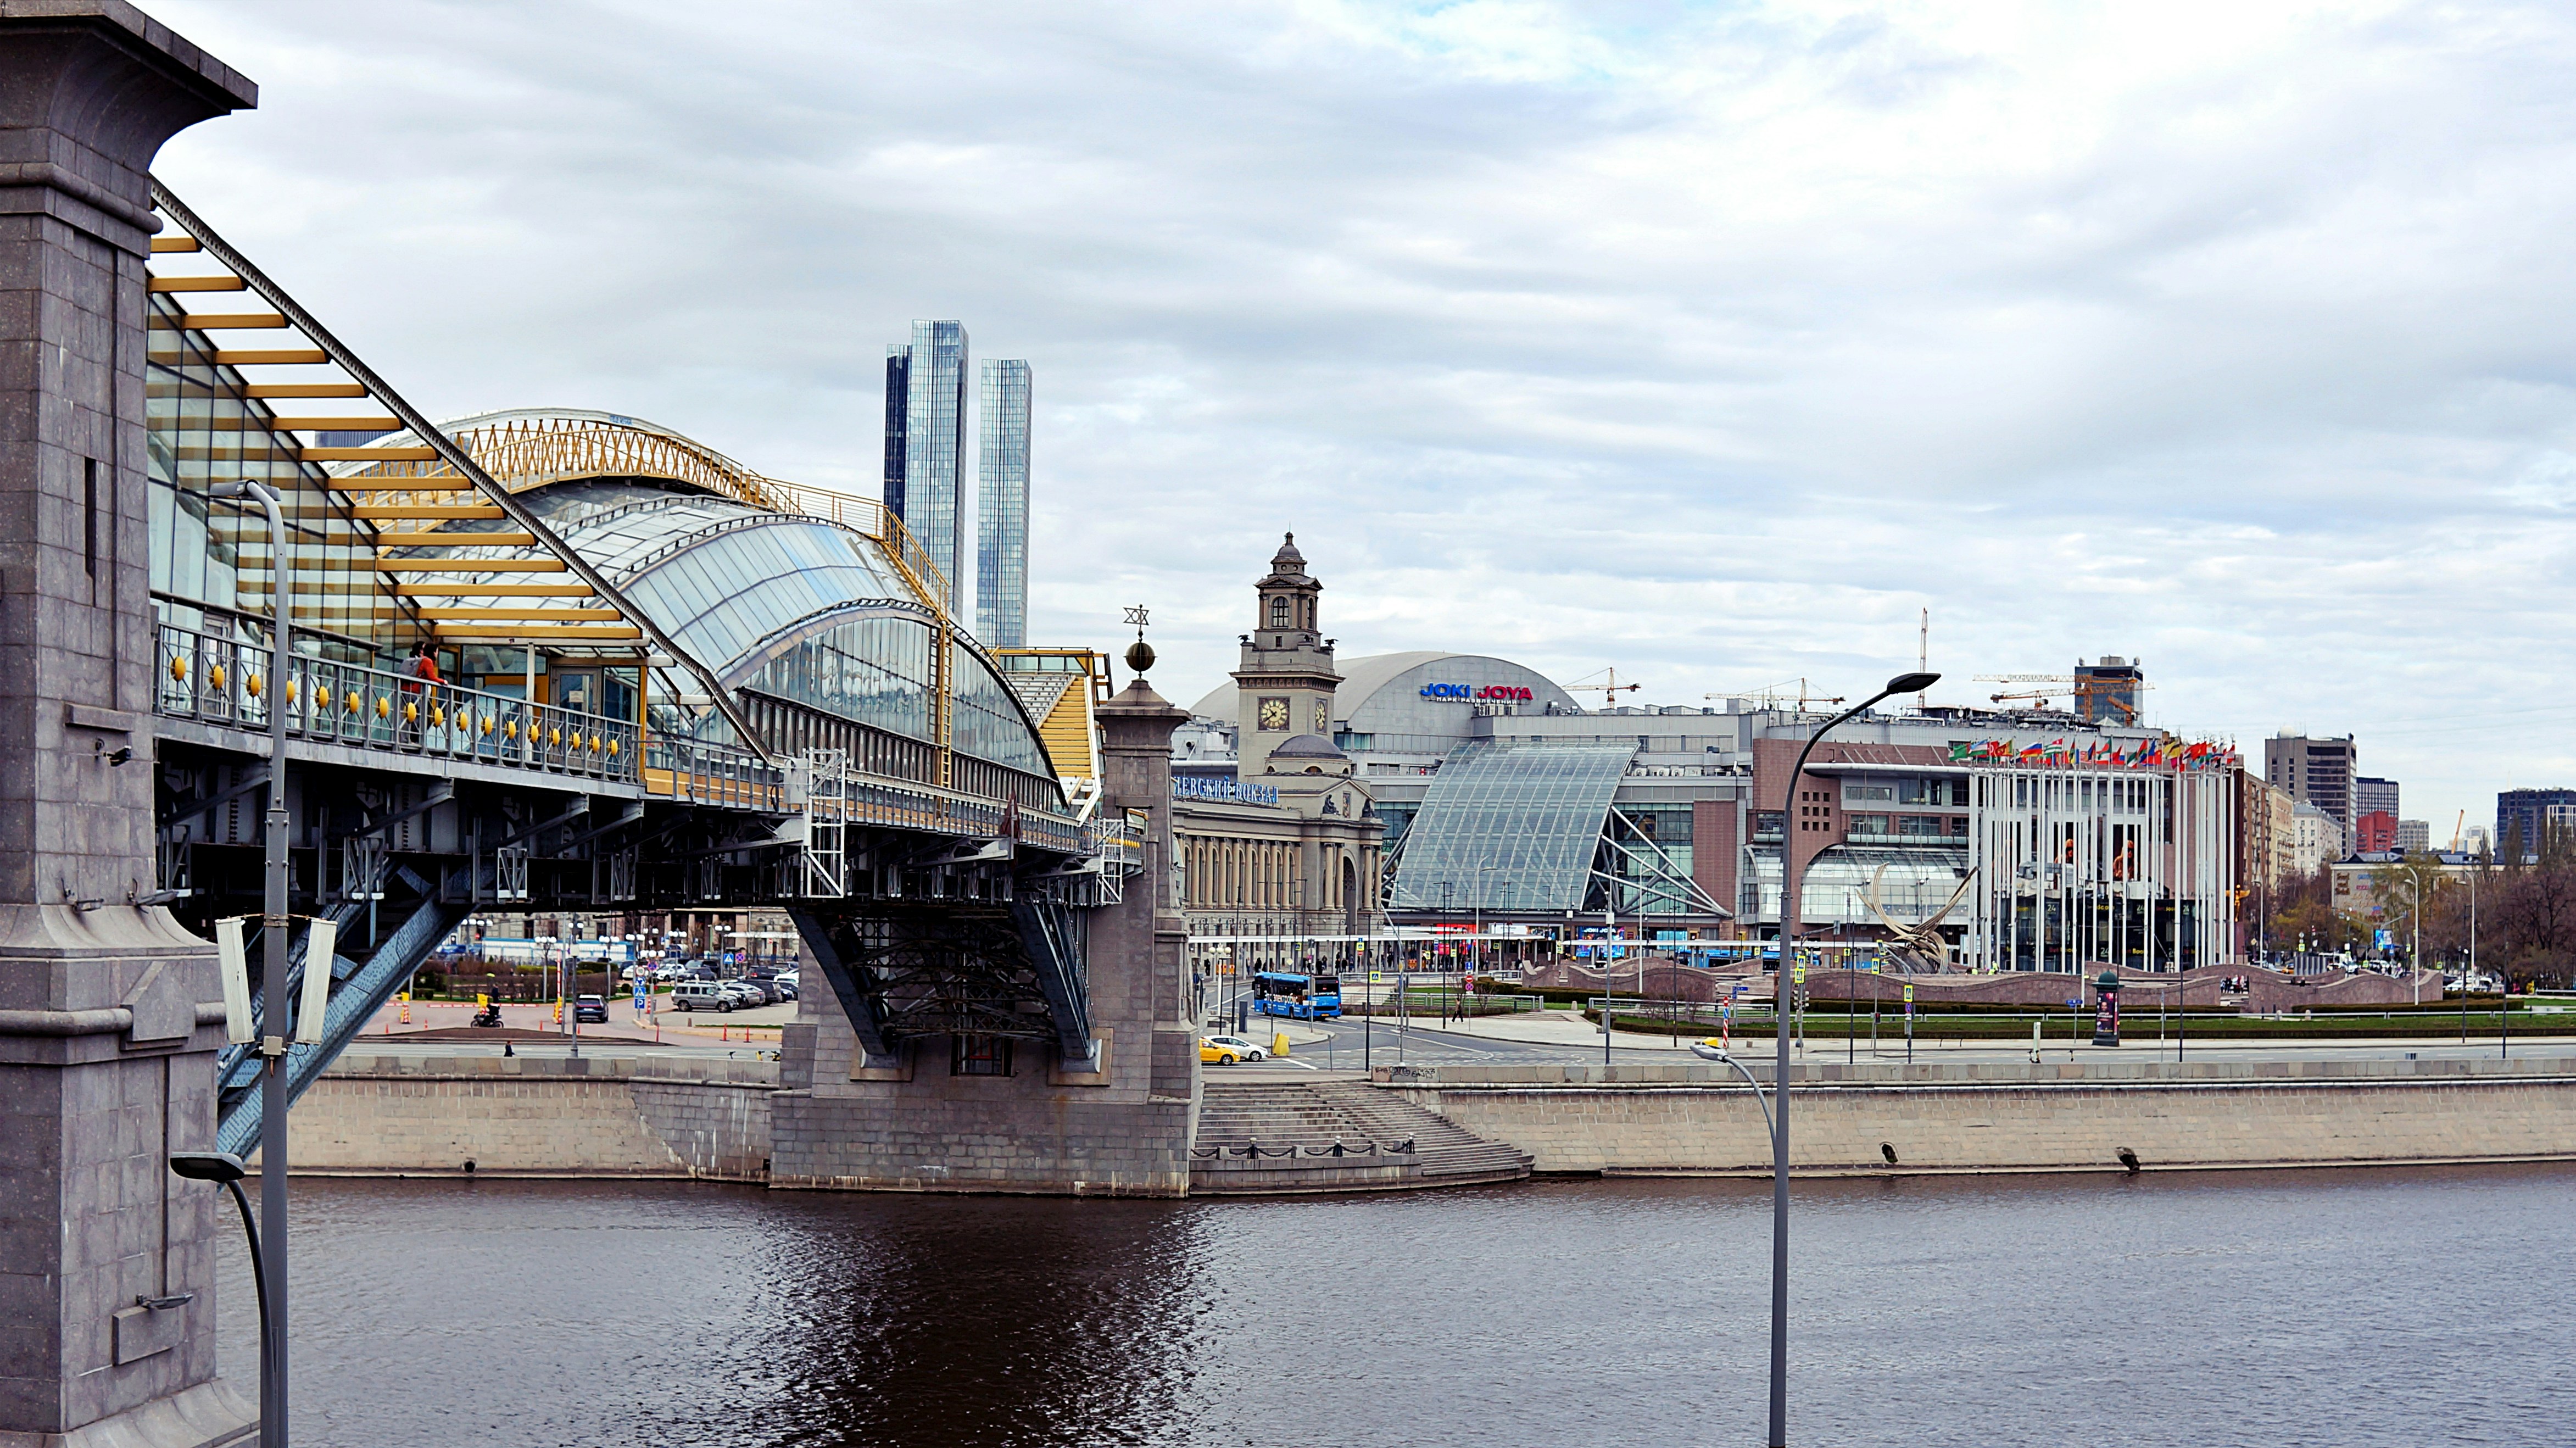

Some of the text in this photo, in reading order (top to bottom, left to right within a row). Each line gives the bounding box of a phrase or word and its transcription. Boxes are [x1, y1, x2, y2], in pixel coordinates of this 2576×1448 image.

[1420, 683, 1533, 700] JOKI JOYA
[1173, 776, 1279, 803] ИЕВСКИЙ ВОКЗАЛ
[2047, 904, 2056, 912] 24
